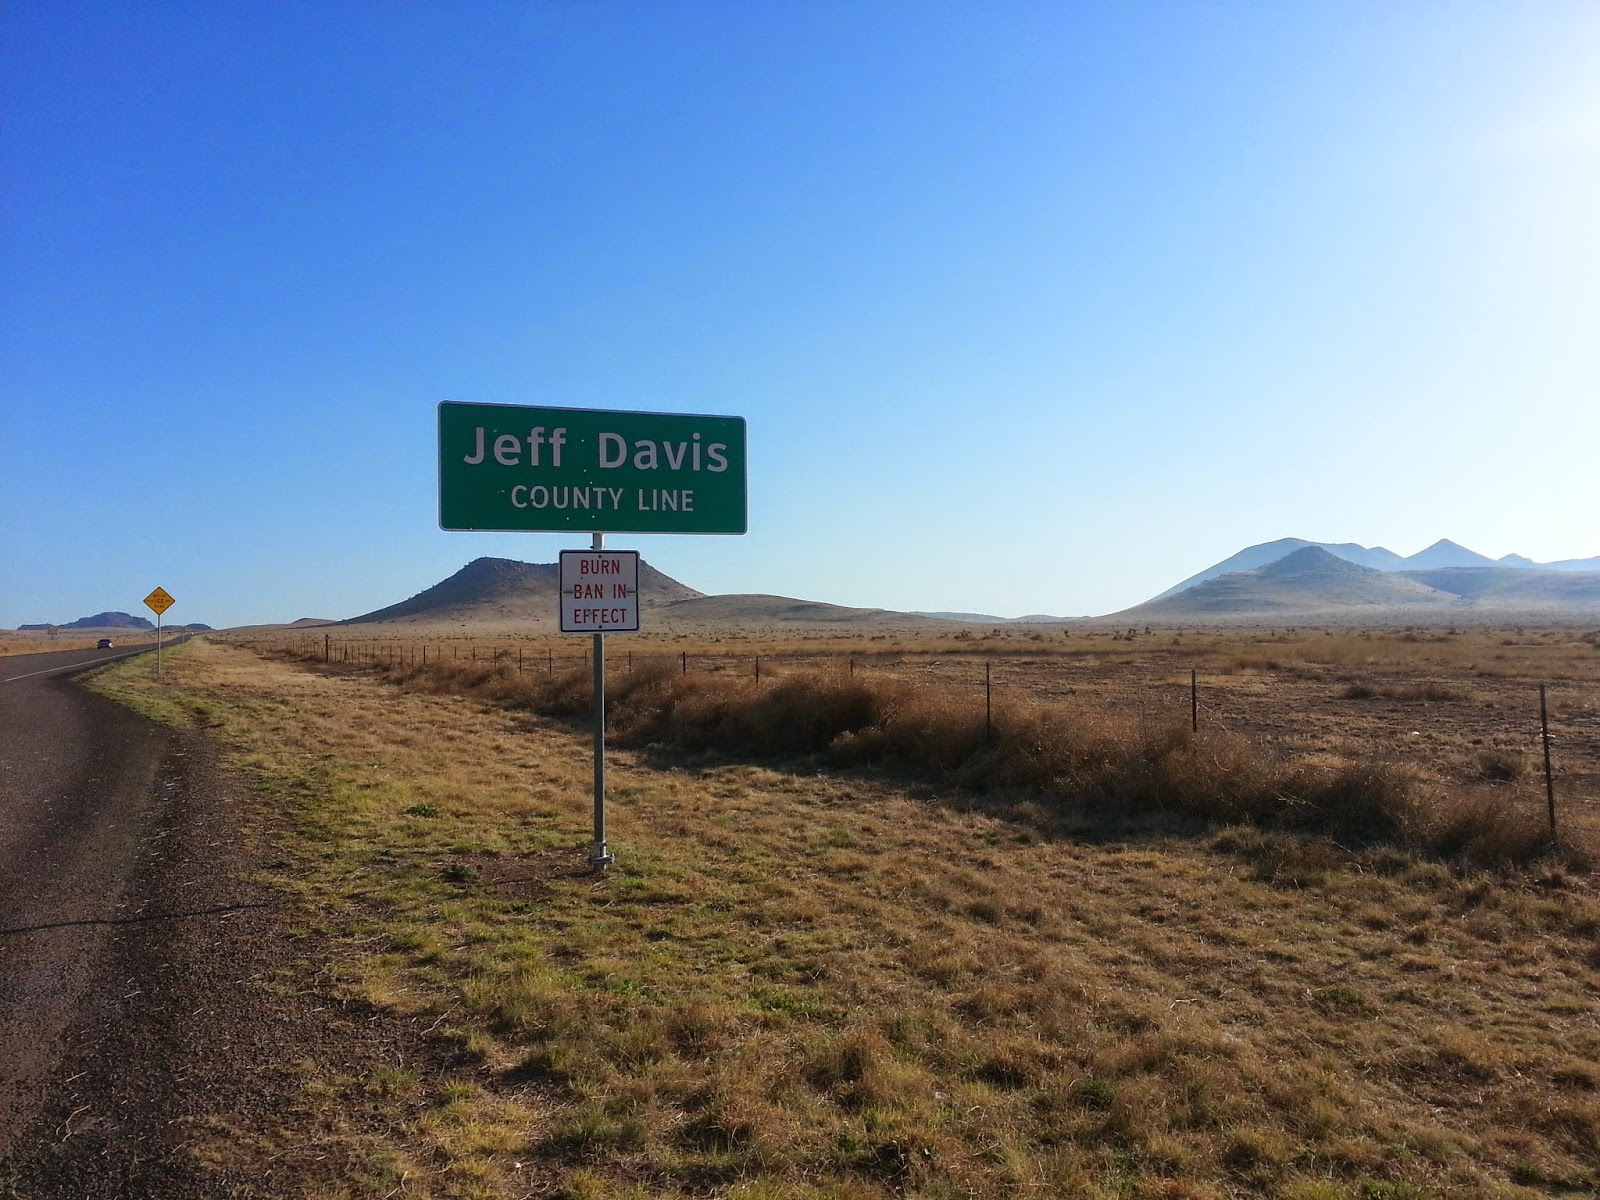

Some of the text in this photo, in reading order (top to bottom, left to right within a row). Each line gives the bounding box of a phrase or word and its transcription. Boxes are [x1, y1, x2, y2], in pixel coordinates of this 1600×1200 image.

[464, 427, 728, 473] Jeff Davis
[511, 485, 694, 512] COUNTY LINE
[580, 559, 621, 575] BURN
[573, 584, 628, 600] BAN IN
[573, 608, 628, 624] EFFECT
